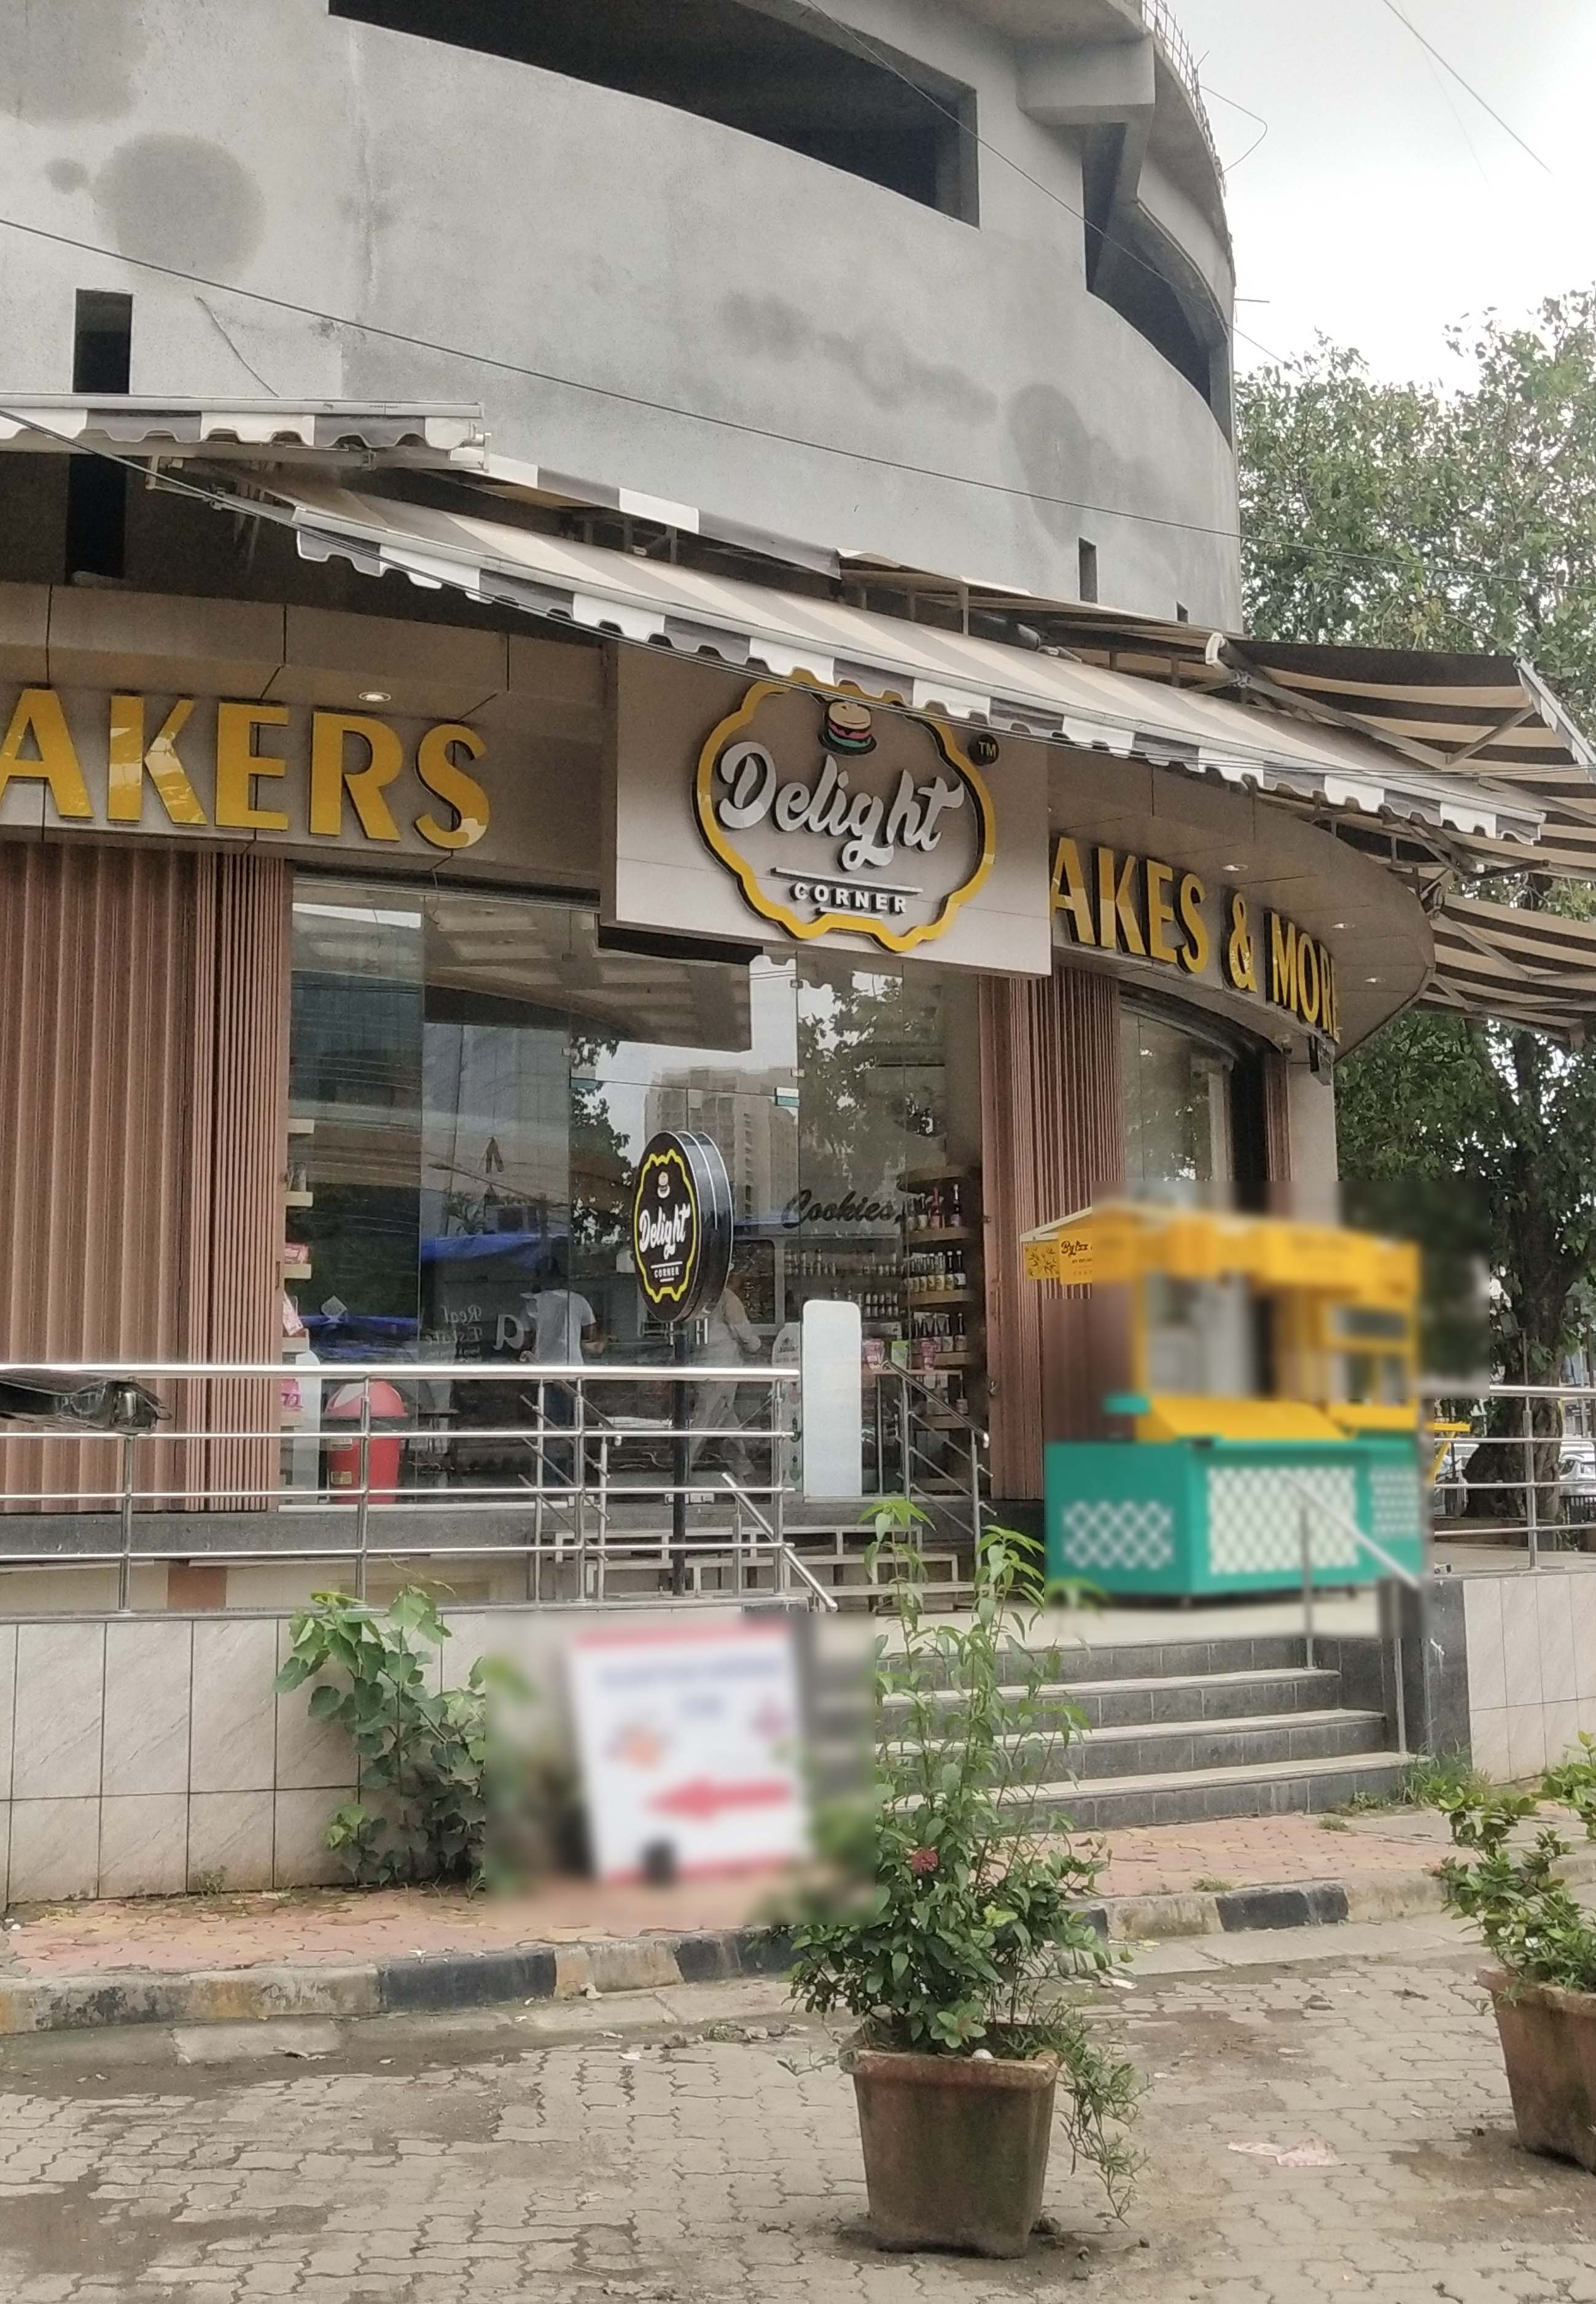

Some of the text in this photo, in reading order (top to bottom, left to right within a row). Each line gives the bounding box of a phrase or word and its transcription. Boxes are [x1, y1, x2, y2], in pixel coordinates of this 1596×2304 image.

[0, 688, 490, 849] AKERS
[978, 741, 997, 757] TM
[717, 741, 964, 871] Delight
[793, 882, 906, 914] CORNER
[1051, 837, 1209, 973] AKES
[1229, 893, 1258, 993] &
[639, 1203, 691, 1259] Delight
[654, 1266, 680, 1278] CORNER
